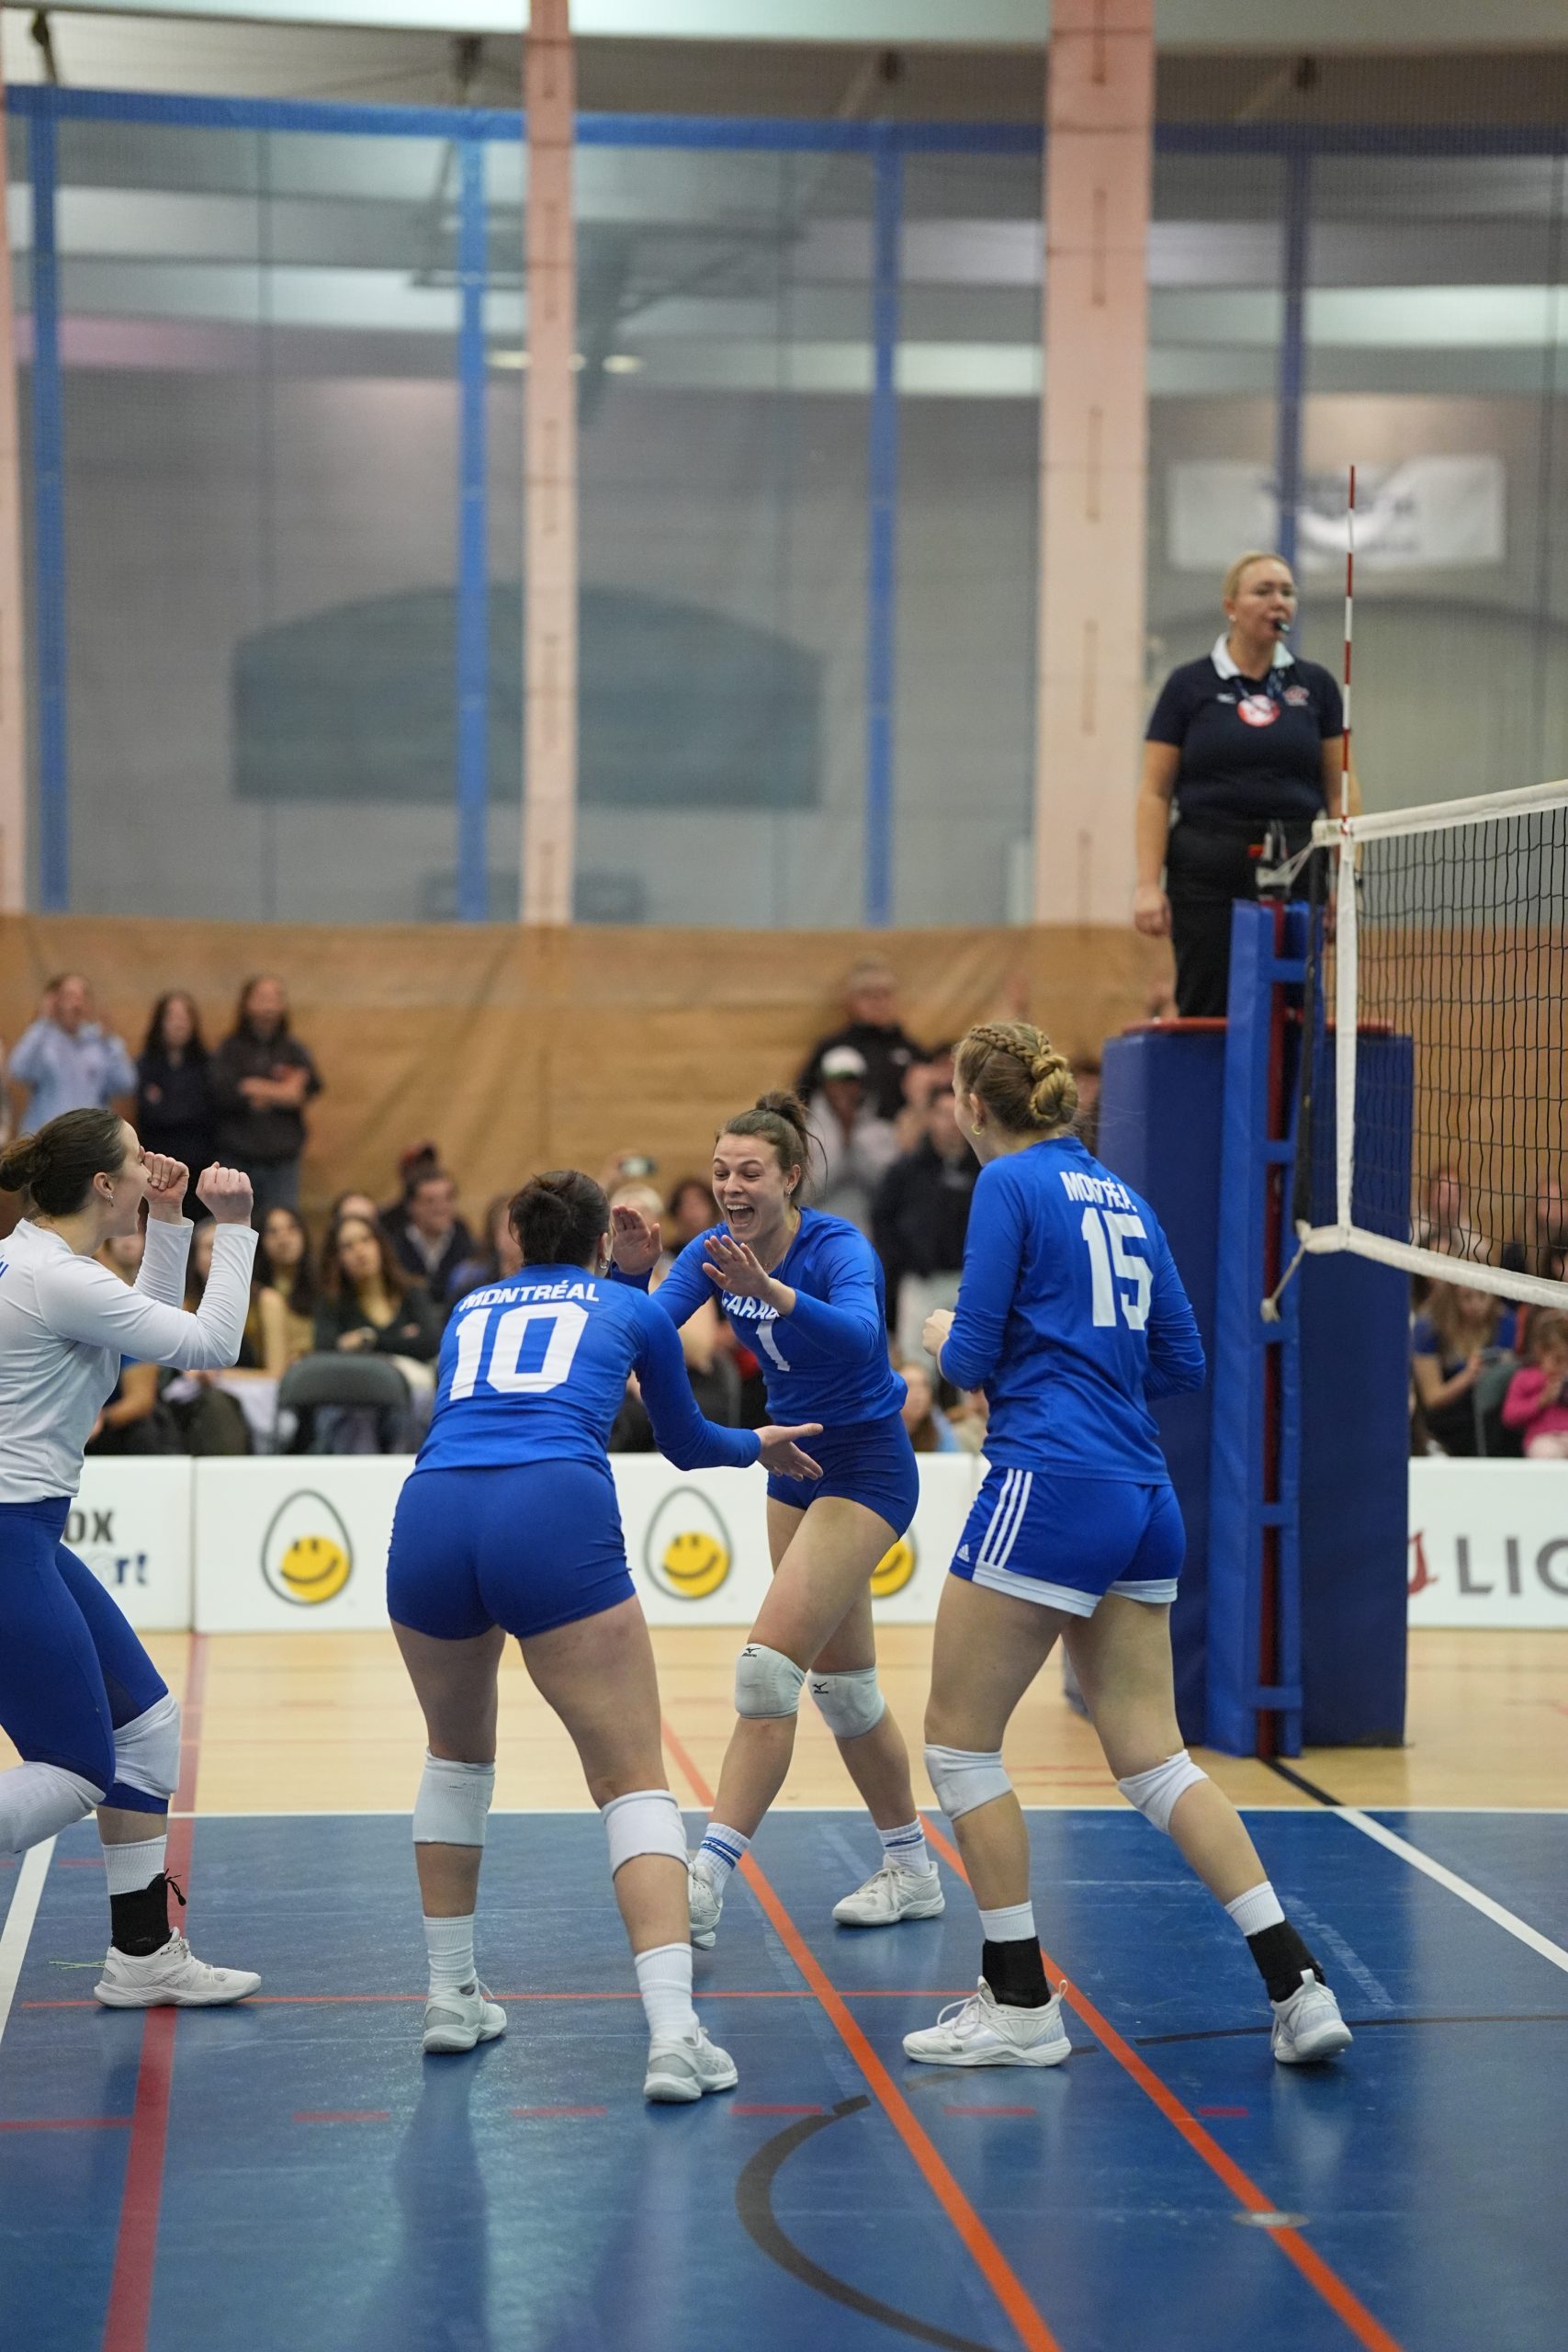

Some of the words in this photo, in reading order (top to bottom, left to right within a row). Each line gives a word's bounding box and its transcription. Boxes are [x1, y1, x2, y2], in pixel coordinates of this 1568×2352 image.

[1059, 1170, 1138, 1213] MONTRÉA
[1081, 1207, 1154, 1330] 15
[458, 1279, 600, 1313] MONTRÉAL
[449, 1301, 589, 1401] 10
[755, 1319, 791, 1372] 1
